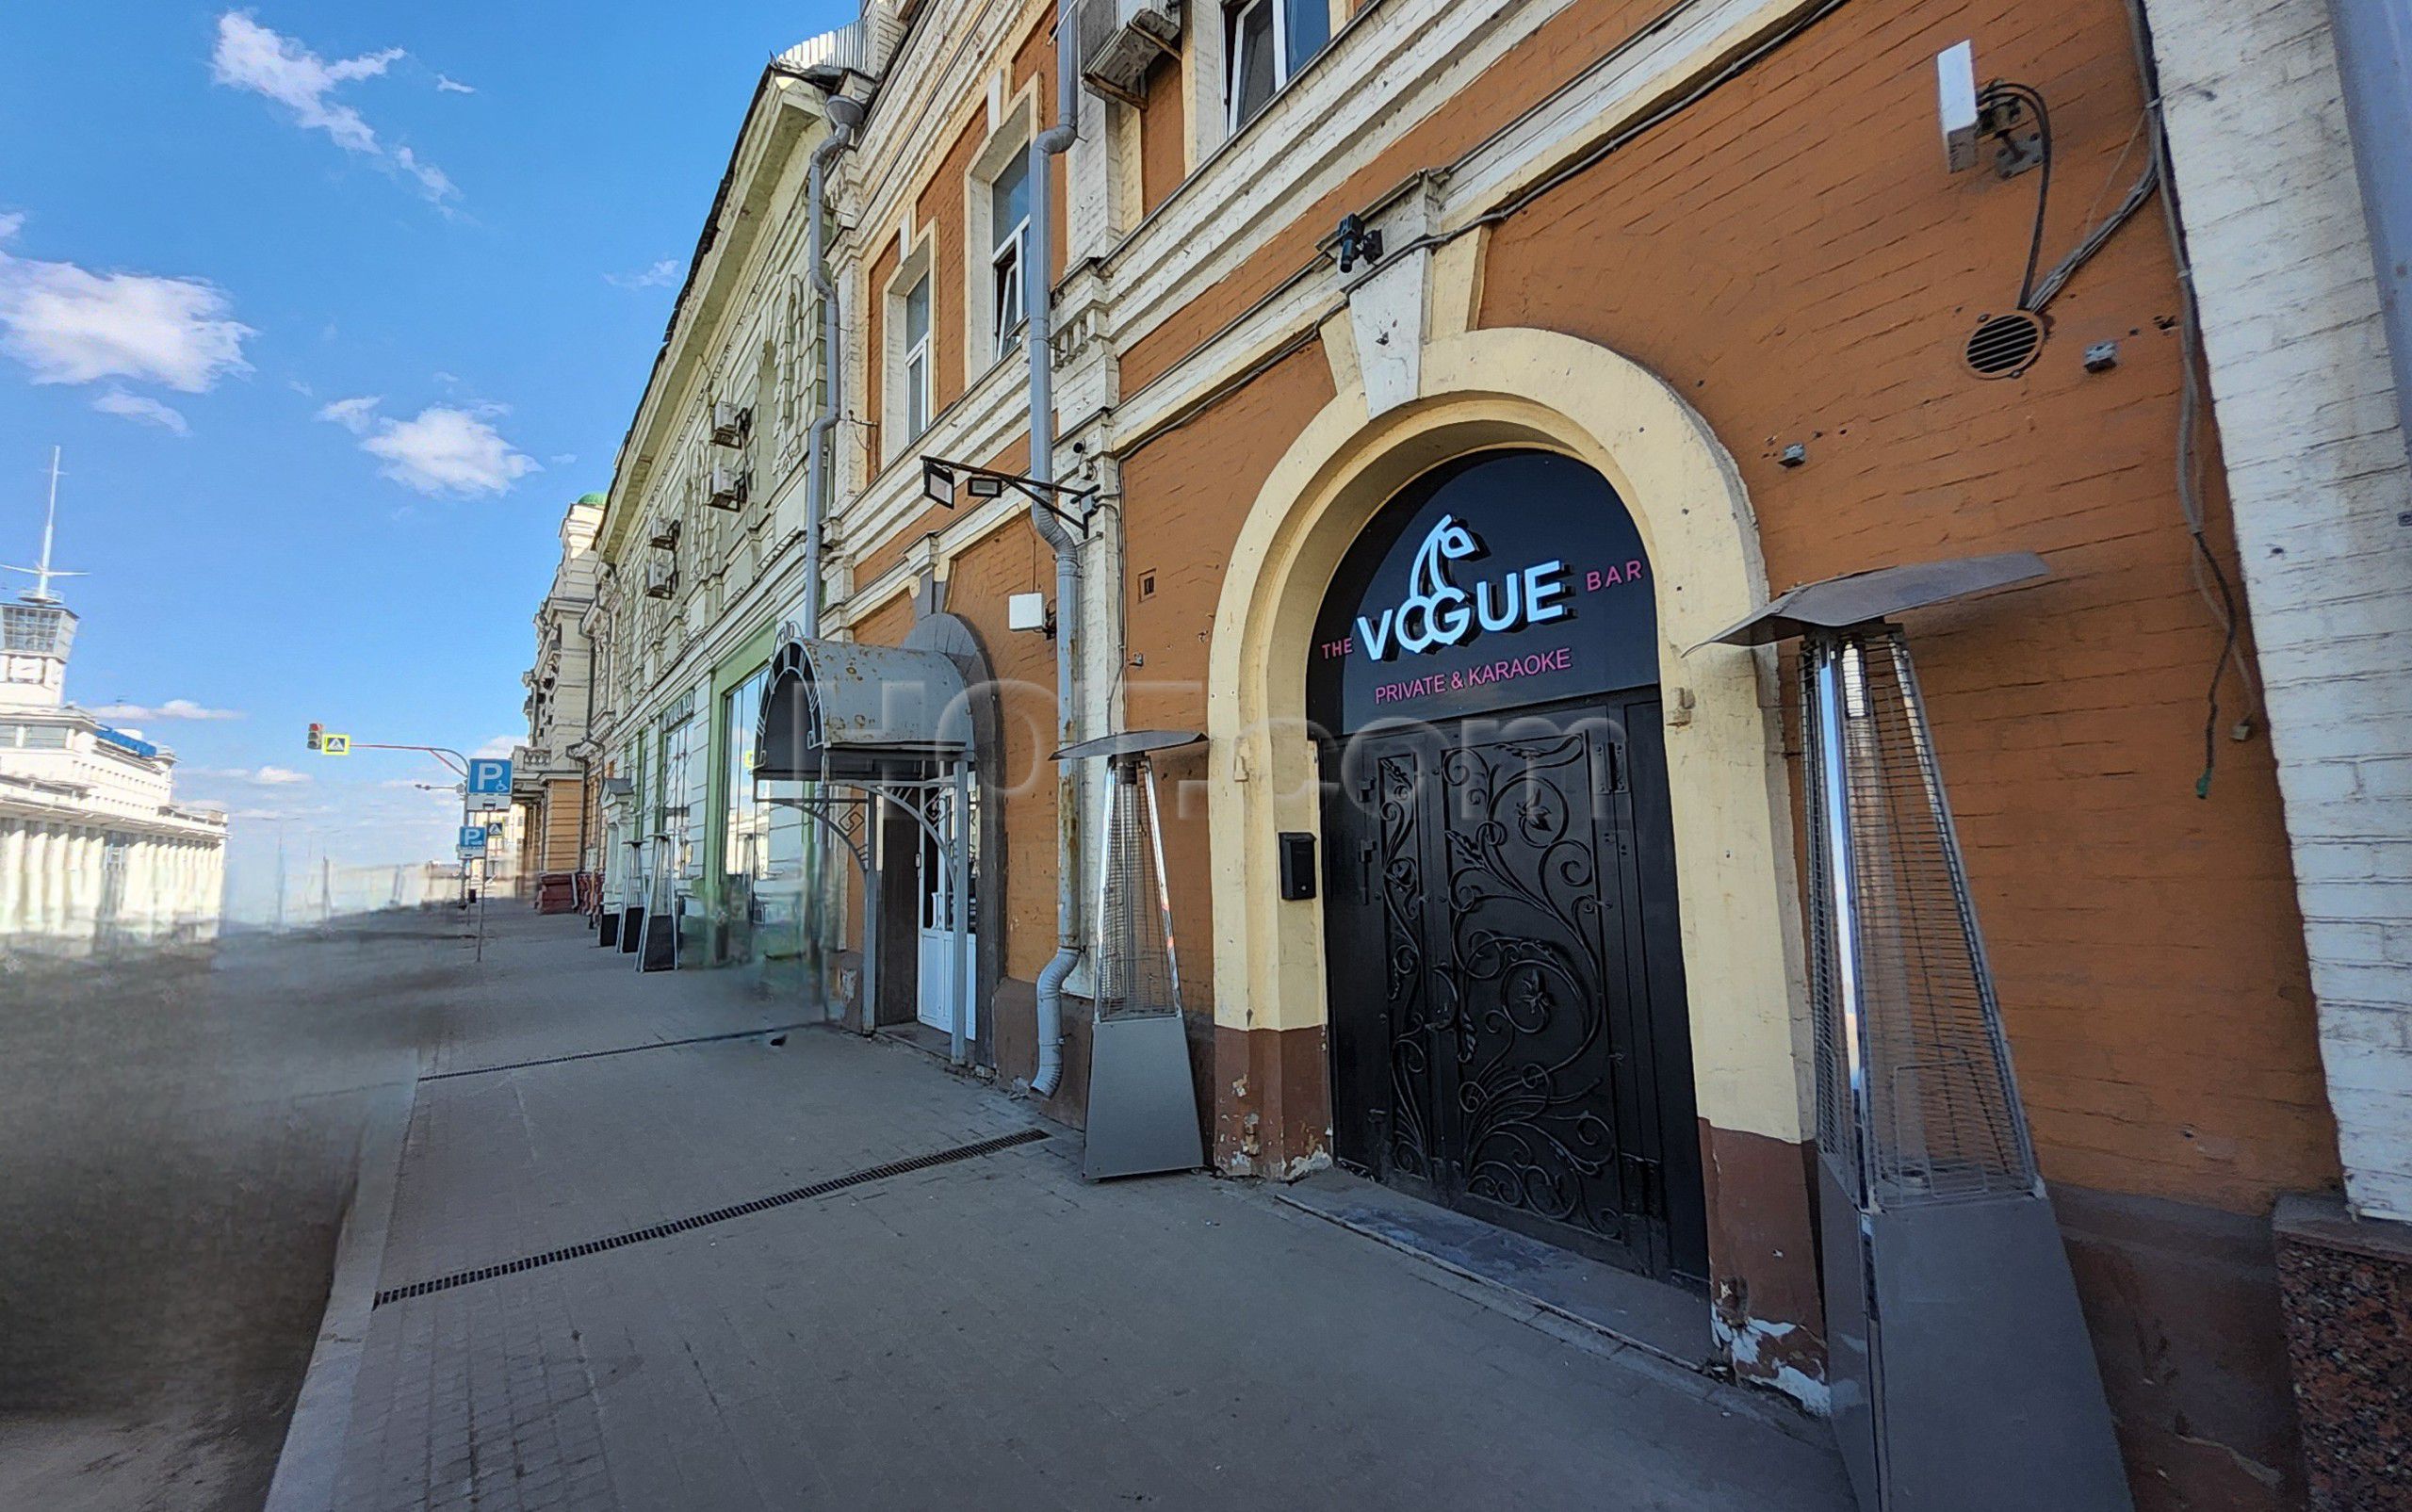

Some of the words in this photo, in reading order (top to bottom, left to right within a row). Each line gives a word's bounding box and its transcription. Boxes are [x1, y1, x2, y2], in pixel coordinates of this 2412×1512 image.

[1322, 638, 1353, 660] THE
[1357, 560, 1565, 661] VOGUE
[1586, 560, 1643, 593] BAR
[1376, 674, 1446, 705] PRIVATE
[1450, 671, 1464, 690] &
[1467, 647, 1572, 686] KARAOKE
[478, 763, 503, 790] P
[464, 829, 481, 845] P
